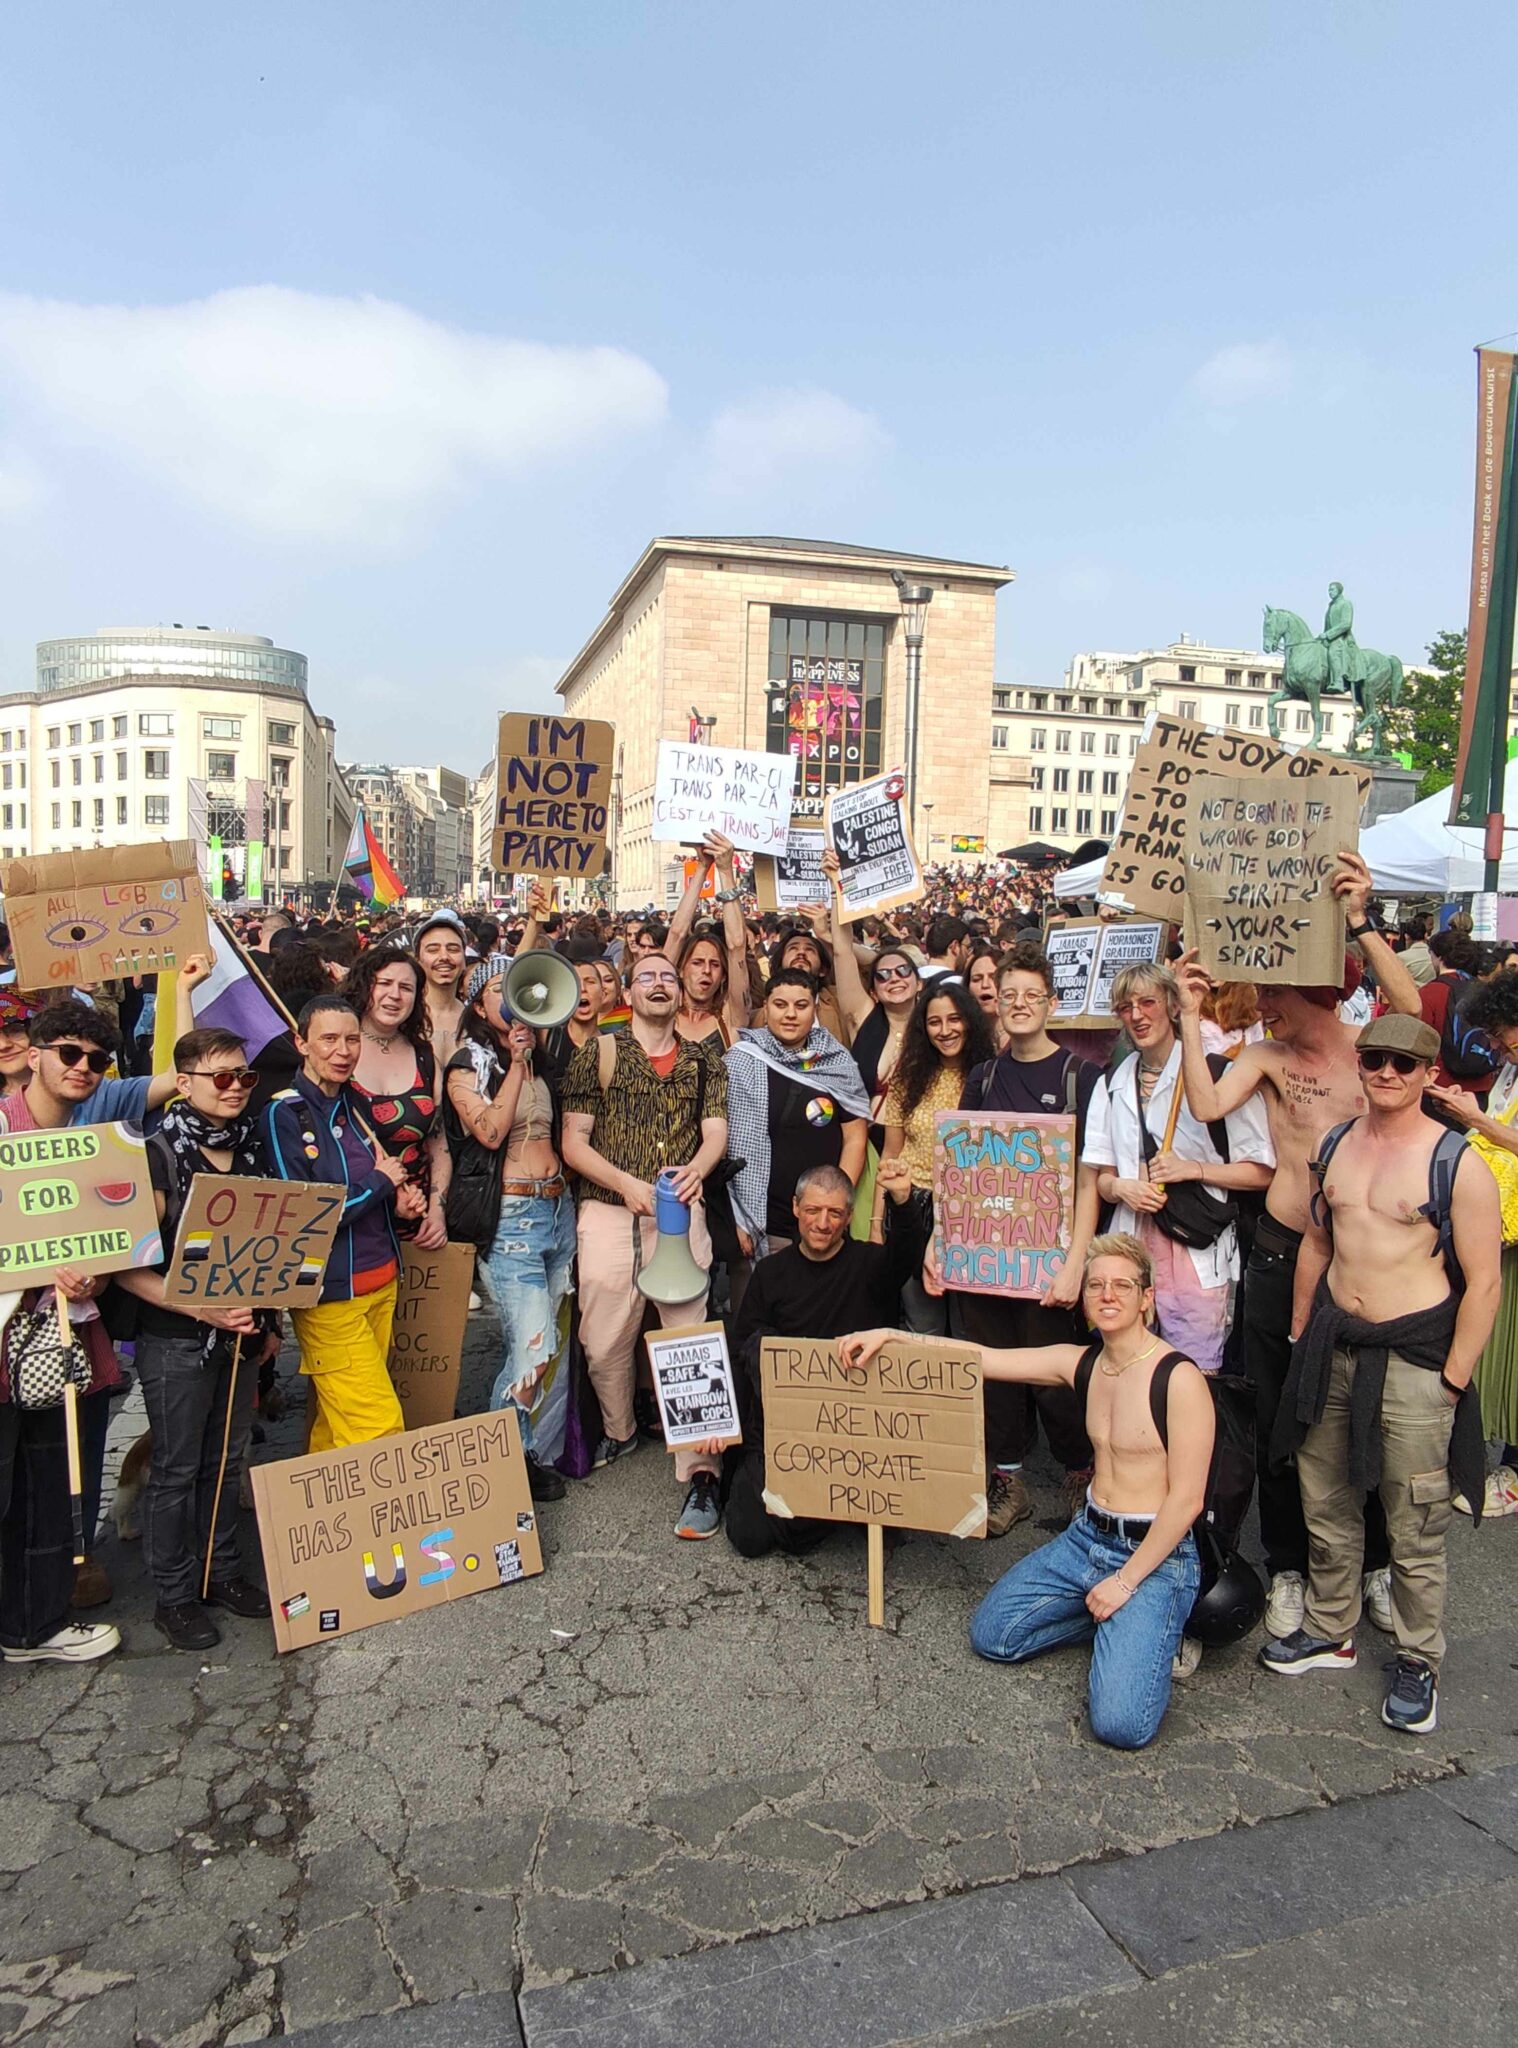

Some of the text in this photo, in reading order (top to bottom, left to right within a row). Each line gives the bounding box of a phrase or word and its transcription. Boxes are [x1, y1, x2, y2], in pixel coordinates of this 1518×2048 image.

[1478, 368, 1495, 609] Musea van het Boek en de Boekdrukkunst
[529, 717, 586, 761] I'M
[790, 743, 859, 760] EXPO
[1156, 721, 1324, 777] THE JOY OF
[507, 755, 600, 799] NOT
[670, 750, 783, 790] TRANS PAR-CI
[670, 778, 713, 800] TRANS
[499, 797, 607, 834] HERE TO
[699, 811, 715, 823] LA
[843, 802, 898, 833] PALESTINE
[1201, 798, 1234, 822] NOT
[1233, 800, 1276, 825] BORN
[1305, 802, 1333, 827] THE
[865, 819, 899, 842] CONGO
[1200, 828, 1317, 851] WRONG BODY
[502, 831, 597, 872] PARTY
[786, 850, 824, 860] PALESTINE
[866, 834, 903, 857] SUDAN
[1119, 831, 1186, 866] TRAN
[801, 861, 821, 870] CONG
[869, 855, 896, 870] EVERYONE
[883, 860, 911, 880] FREE
[1105, 861, 1141, 885] IS
[1229, 853, 1259, 877] THE
[1267, 854, 1334, 880] WRONG
[48, 898, 76, 917] ALL
[1108, 933, 1154, 946] HORMONES
[1226, 915, 1289, 942] YOUR
[1056, 937, 1088, 951] JAMAIS
[1105, 946, 1152, 959] GRATUITES
[49, 956, 77, 980] ON
[99, 947, 177, 975] RAFAH
[1063, 988, 1085, 1000] COPS
[0, 1135, 97, 1167] QUEERS
[945, 1129, 1042, 1173] TRANS
[22, 1185, 74, 1211] FOR
[944, 1167, 1060, 1210] RIGHTS
[206, 1188, 342, 1237] OTEZ
[982, 1196, 1015, 1211] ARE
[942, 1201, 1059, 1249] HUMAN
[0, 1231, 129, 1268] PALESTINE
[223, 1235, 309, 1267] VOS
[178, 1263, 293, 1297] SEXES
[943, 1244, 1068, 1291] RIGHTS
[666, 1346, 711, 1366] JAMAIS
[764, 1347, 978, 1391] TRANS RIGHTS
[666, 1384, 693, 1396] AVEC LES
[675, 1388, 728, 1411] RAINBOW
[700, 1404, 731, 1421] COPS
[816, 1402, 930, 1440] ARE NOT
[773, 1441, 926, 1482] CORPORATE
[290, 1459, 366, 1509] THE
[829, 1484, 904, 1516] PRIDE
[289, 1474, 491, 1564] HAS FAILED
